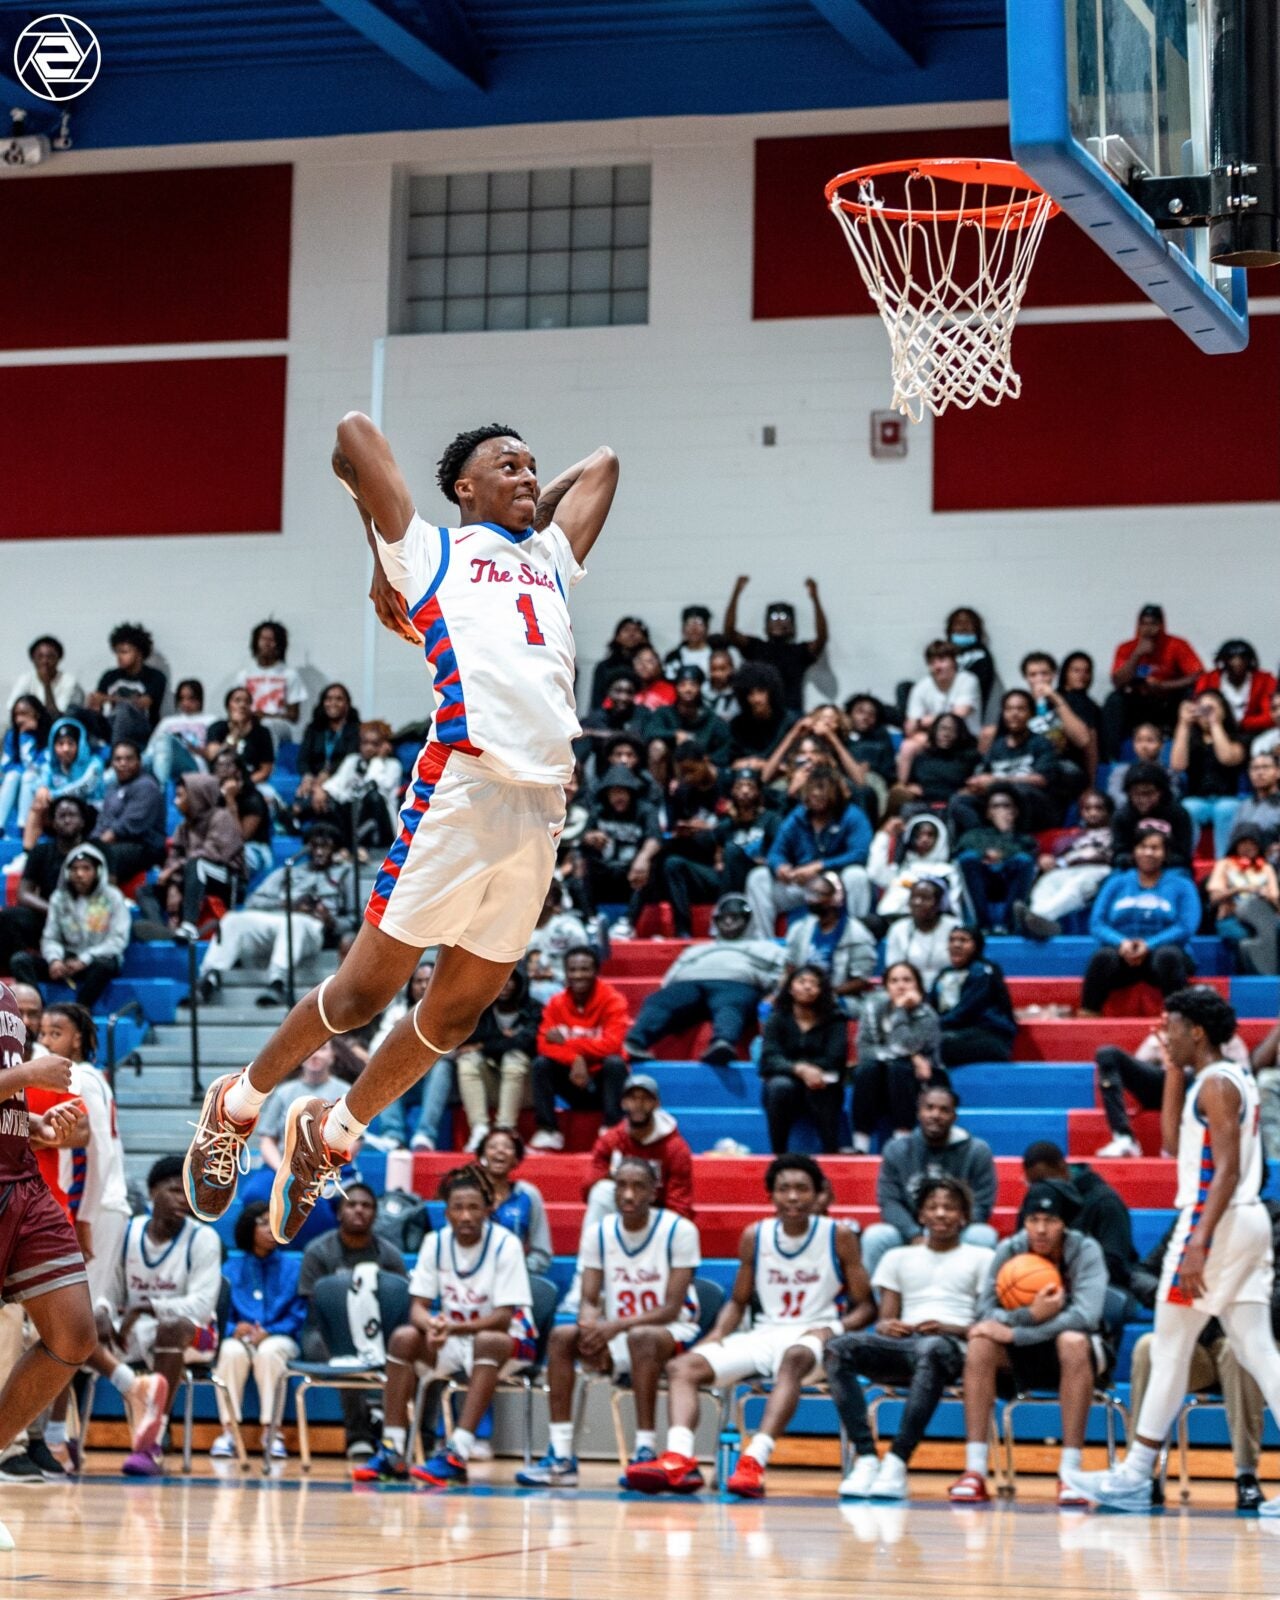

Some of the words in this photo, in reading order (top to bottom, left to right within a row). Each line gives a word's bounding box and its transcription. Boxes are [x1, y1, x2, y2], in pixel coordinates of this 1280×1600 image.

[470, 558, 513, 583] The
[516, 593, 546, 646] 1
[617, 1290, 659, 1319] 30
